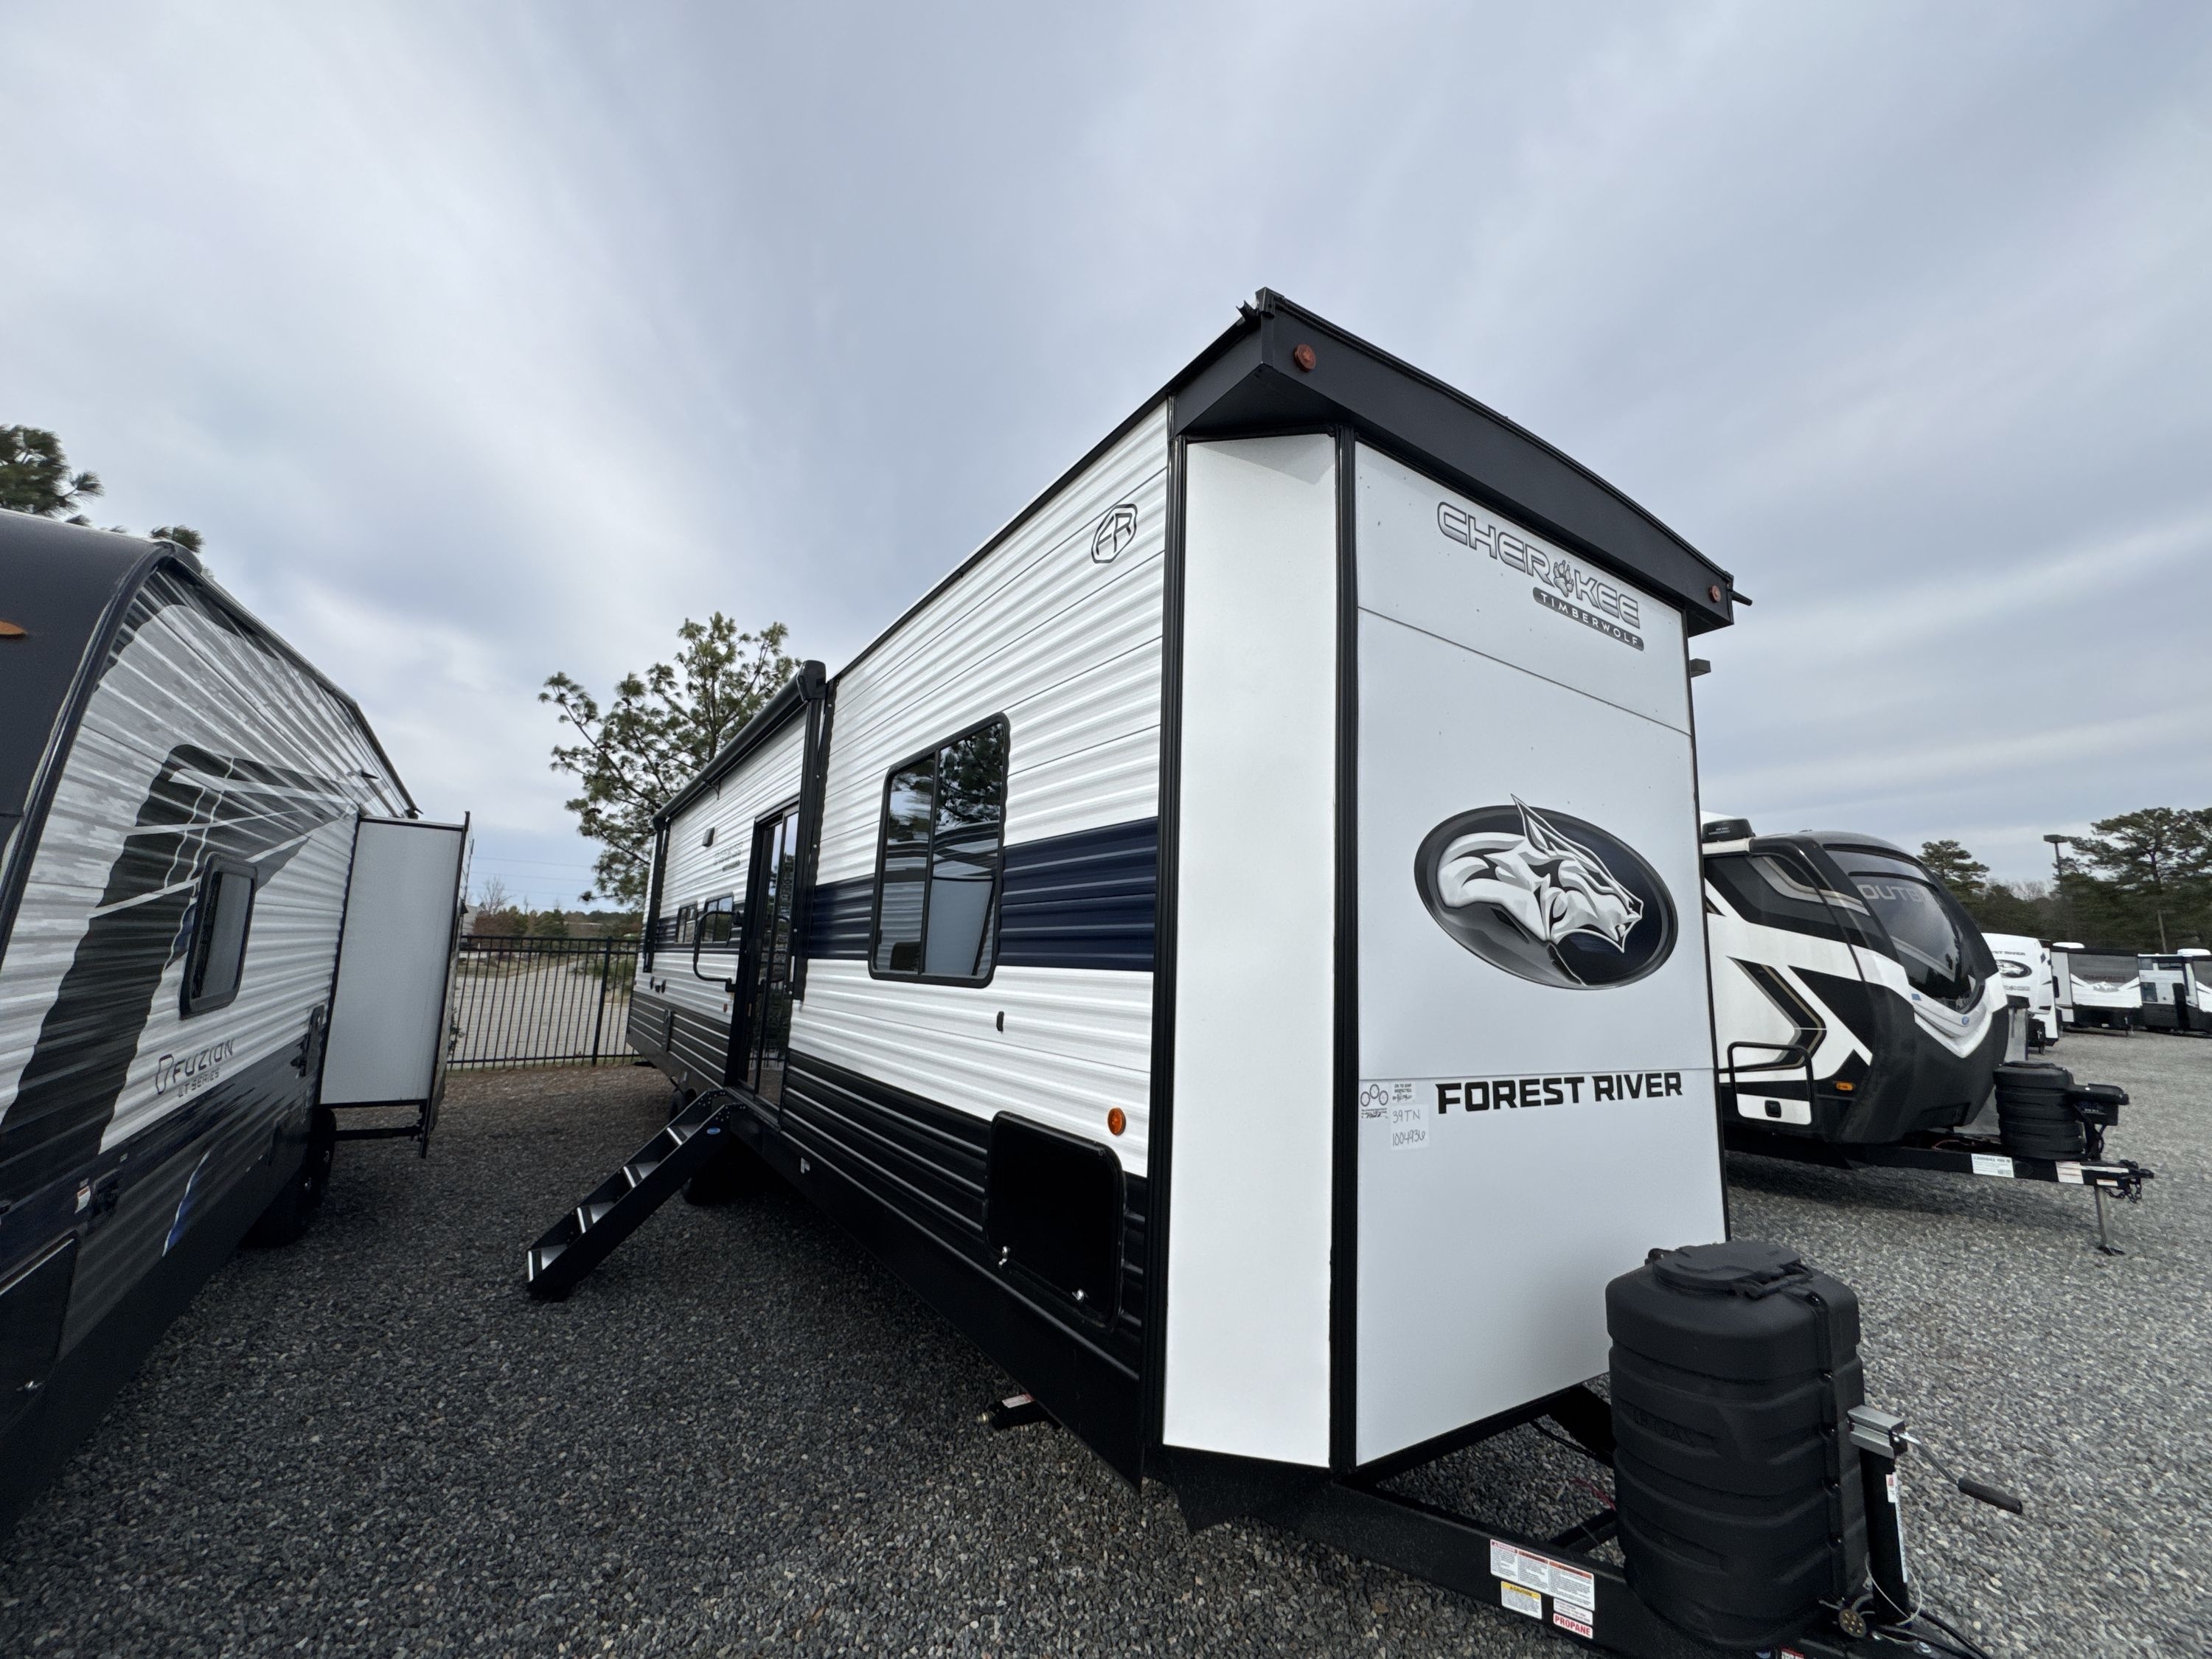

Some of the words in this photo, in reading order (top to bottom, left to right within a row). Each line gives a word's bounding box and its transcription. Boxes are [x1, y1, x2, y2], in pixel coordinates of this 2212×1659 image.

[1540, 592, 1638, 646] TIMBERWOLF
[173, 1037, 235, 1084] FUZION
[1435, 1076, 1585, 1114] FOREST
[1591, 1071, 1683, 1102] RIVER
[1554, 1614, 1591, 1637] PROPANE
